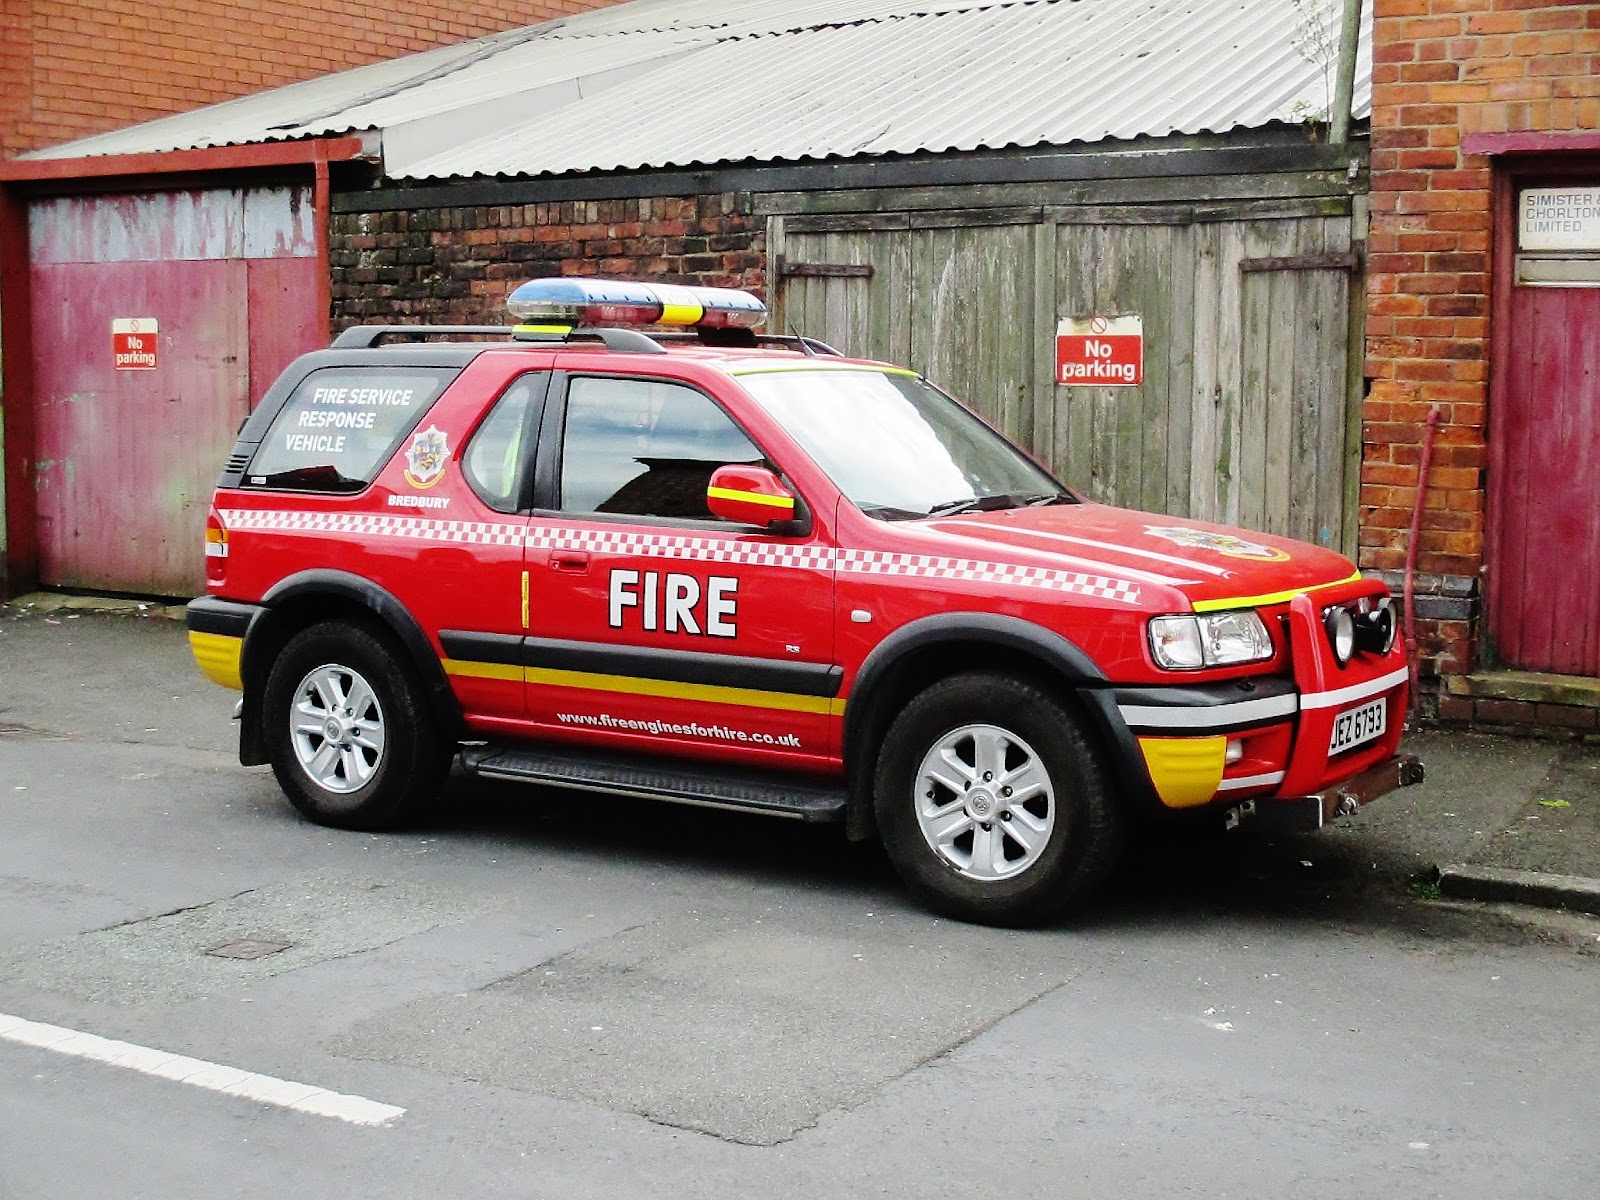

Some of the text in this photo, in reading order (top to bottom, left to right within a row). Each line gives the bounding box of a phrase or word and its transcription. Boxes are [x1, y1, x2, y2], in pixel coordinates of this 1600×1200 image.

[1526, 194, 1593, 206] SIMISTER
[1526, 207, 1600, 219] CHORLTON
[127, 336, 143, 349] No
[1084, 340, 1113, 358] No
[116, 350, 156, 367] parking
[1062, 360, 1135, 381] parking
[313, 388, 413, 406] FIRE SERVICE
[298, 411, 376, 428] RESPONSE
[286, 434, 346, 453] VEHICLE
[388, 494, 450, 509] BREDBURY
[608, 568, 739, 639] FIRE
[557, 712, 801, 748] www.fireenginesforhire.co.uk
[1331, 704, 1382, 749] JEZ 6793
